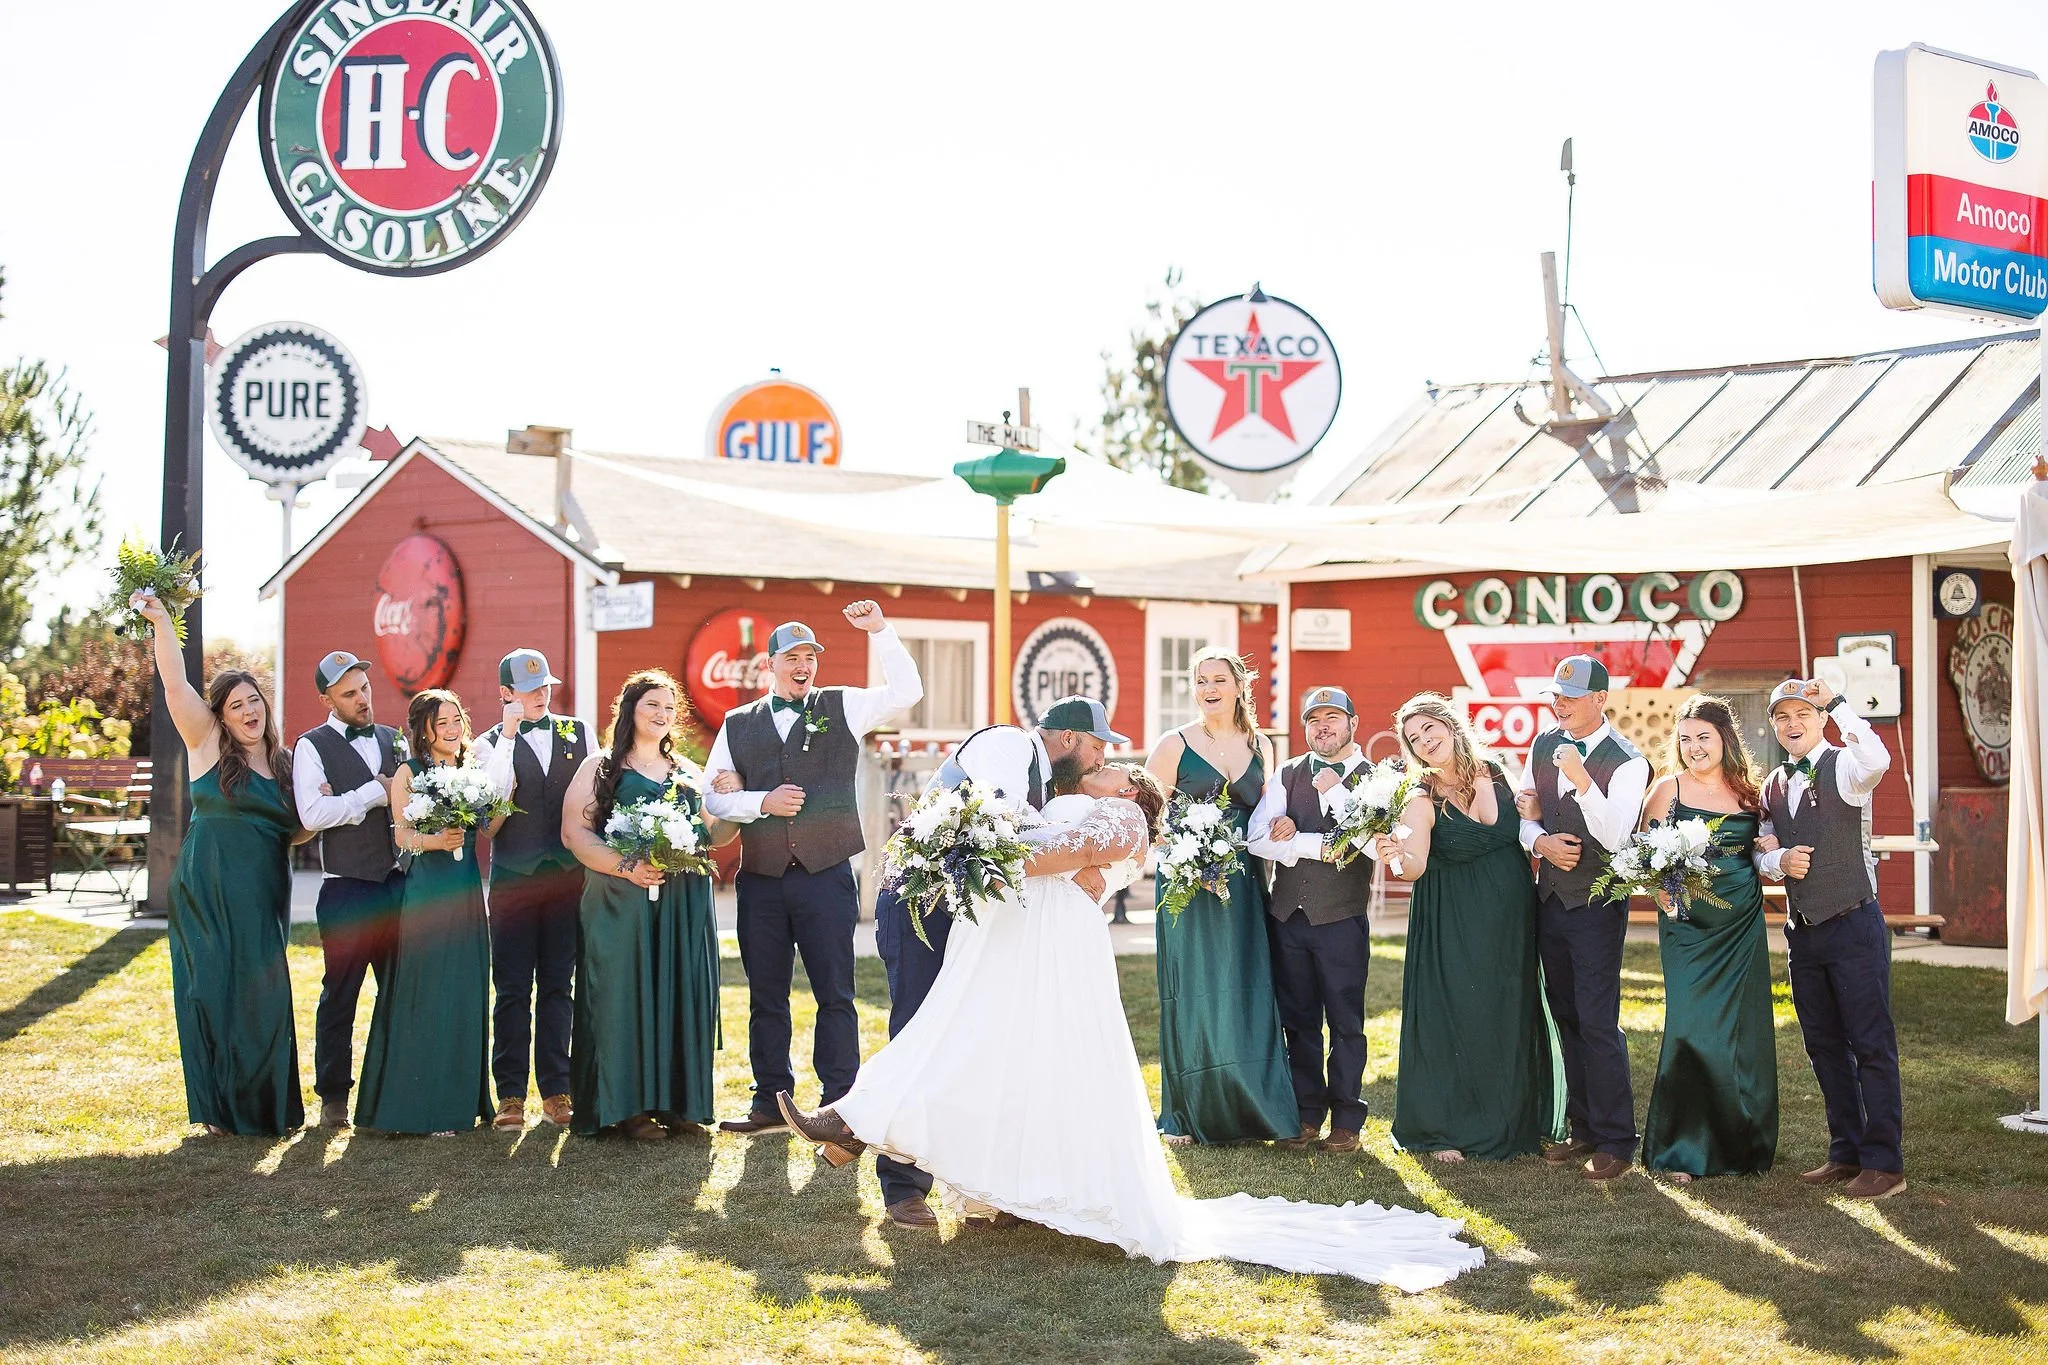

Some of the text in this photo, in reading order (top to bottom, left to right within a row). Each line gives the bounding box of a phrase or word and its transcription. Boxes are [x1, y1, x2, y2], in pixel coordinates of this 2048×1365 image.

[1968, 120, 2019, 145] AMOCO
[289, 153, 530, 262] GASOLINE
[1956, 192, 2031, 236] Amoco
[1934, 248, 2047, 300] Motor Club
[1193, 335, 1319, 357] TEXACO
[245, 381, 331, 418] PURE
[725, 421, 830, 464] GULF
[977, 424, 996, 443] THE
[1414, 570, 1744, 630] CONOCO
[1037, 671, 1094, 701] PURE
